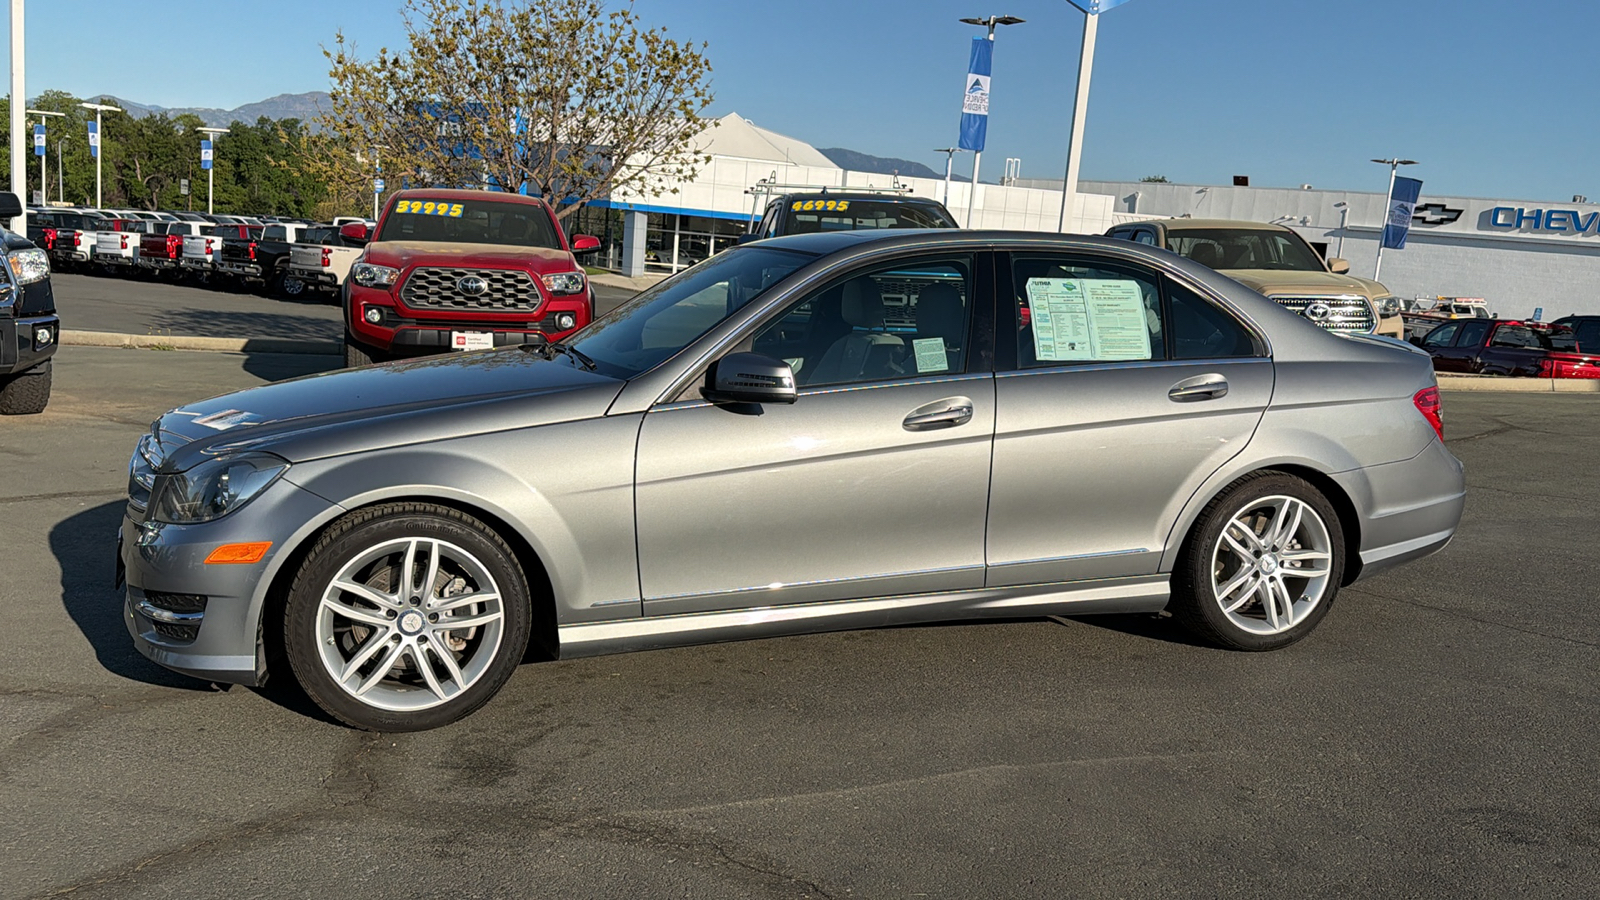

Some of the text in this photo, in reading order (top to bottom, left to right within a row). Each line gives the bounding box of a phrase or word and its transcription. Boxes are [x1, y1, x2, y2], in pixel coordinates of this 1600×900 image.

[395, 200, 464, 217] 39995
[792, 200, 850, 212] 46995
[1490, 206, 1600, 233] CHEV
[405, 521, 454, 534] Continental
